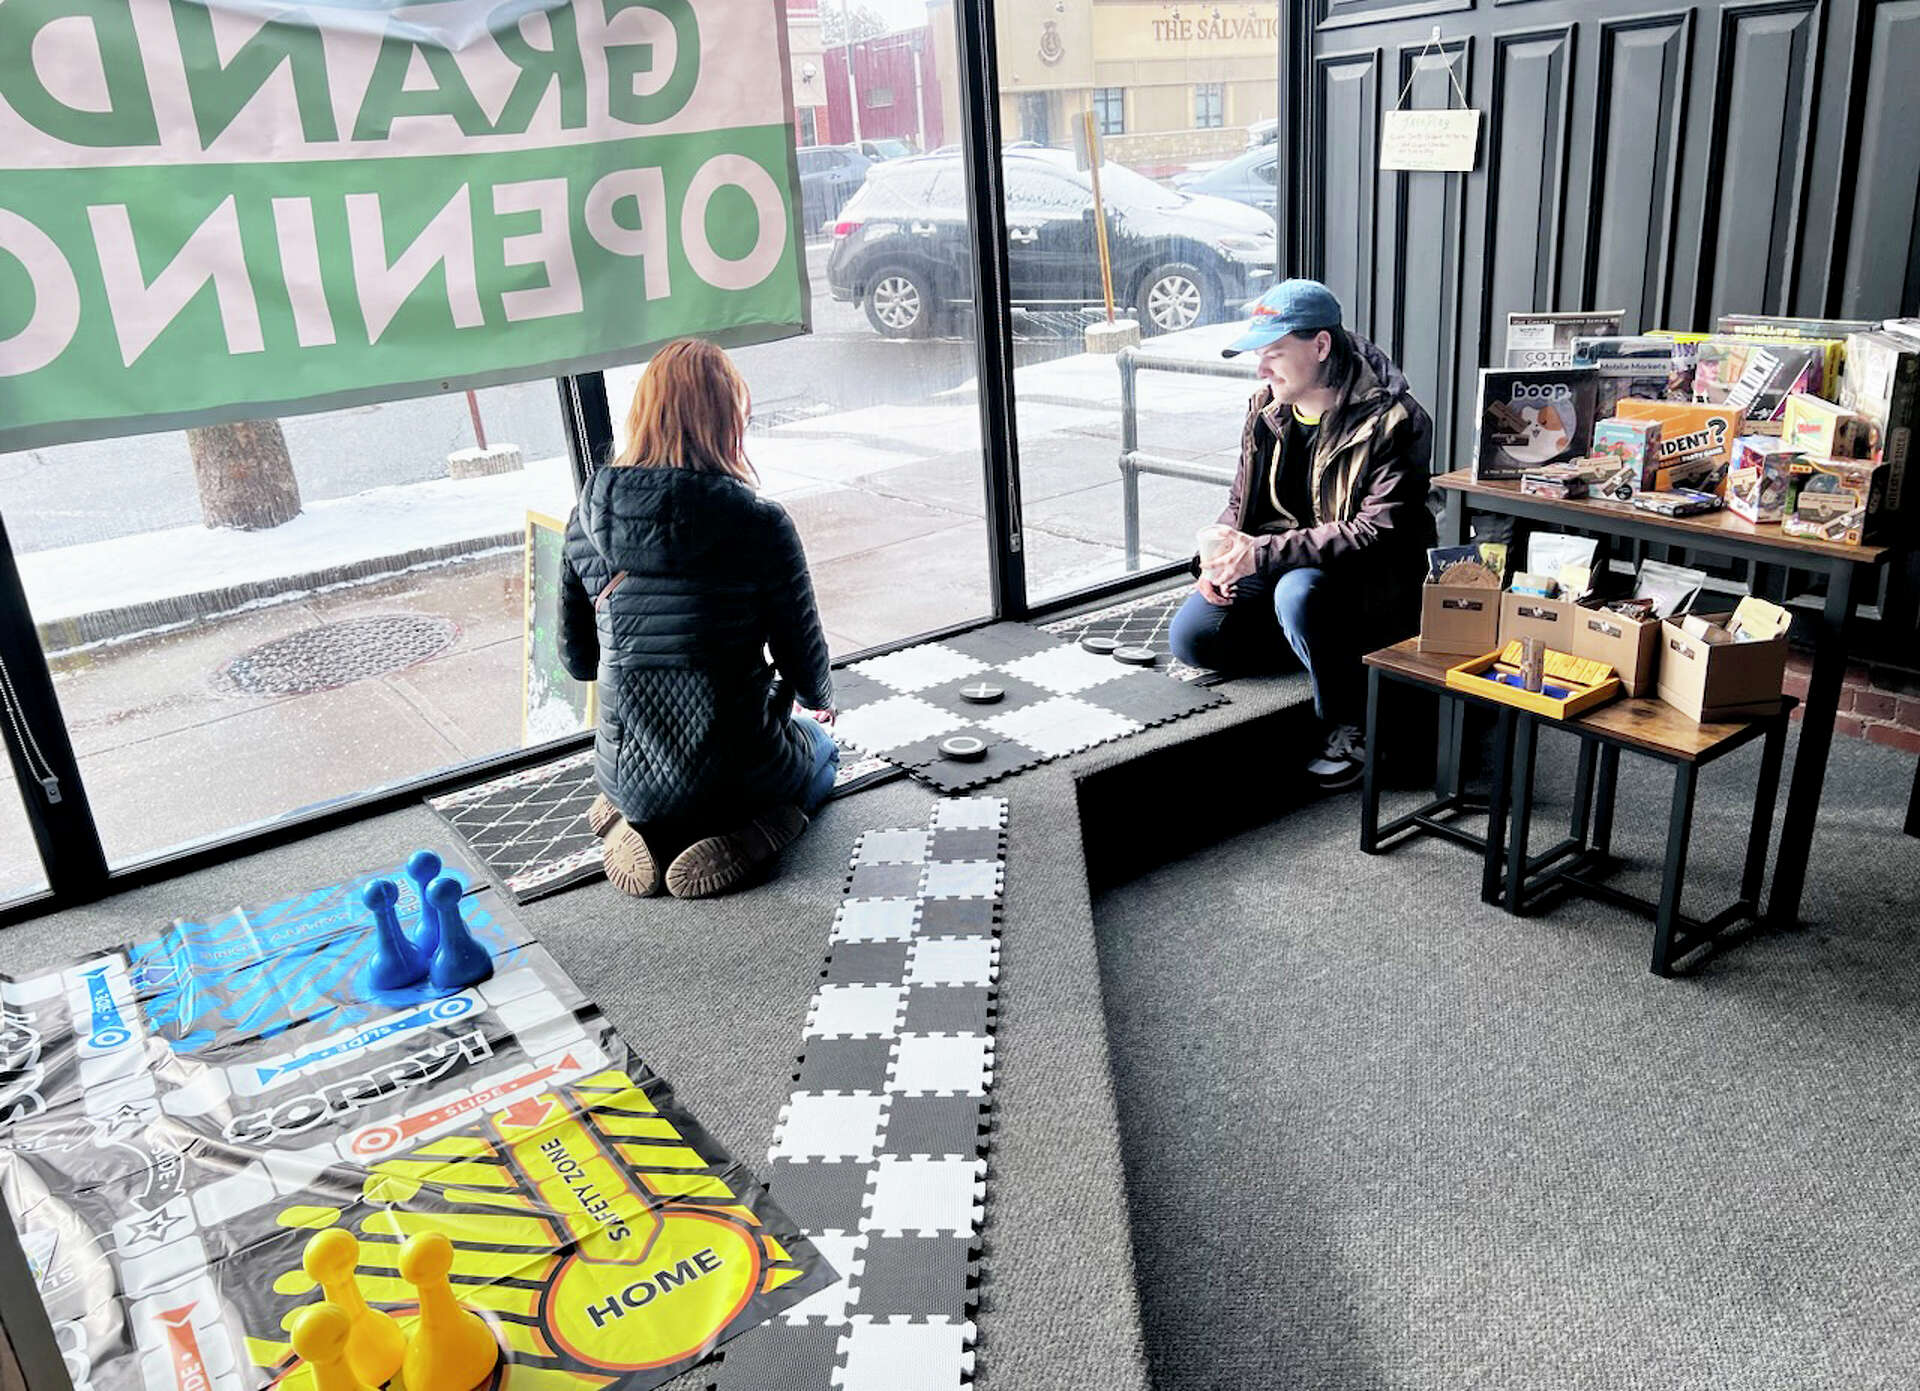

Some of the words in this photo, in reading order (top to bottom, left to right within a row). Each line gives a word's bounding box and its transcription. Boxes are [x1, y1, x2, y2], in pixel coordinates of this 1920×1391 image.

[1151, 19, 1193, 41] THE
[1525, 351, 1571, 361] COTT
[1600, 362, 1630, 370] Mobile
[1660, 417, 1728, 456] IDENT?
[334, 1022, 392, 1053] SLIDE
[222, 1029, 494, 1145] SORRY!
[444, 1084, 505, 1117] SLIDE
[540, 1138, 586, 1184] ZONE
[572, 1183, 631, 1242] SAFETY
[586, 1247, 723, 1328] HOME
